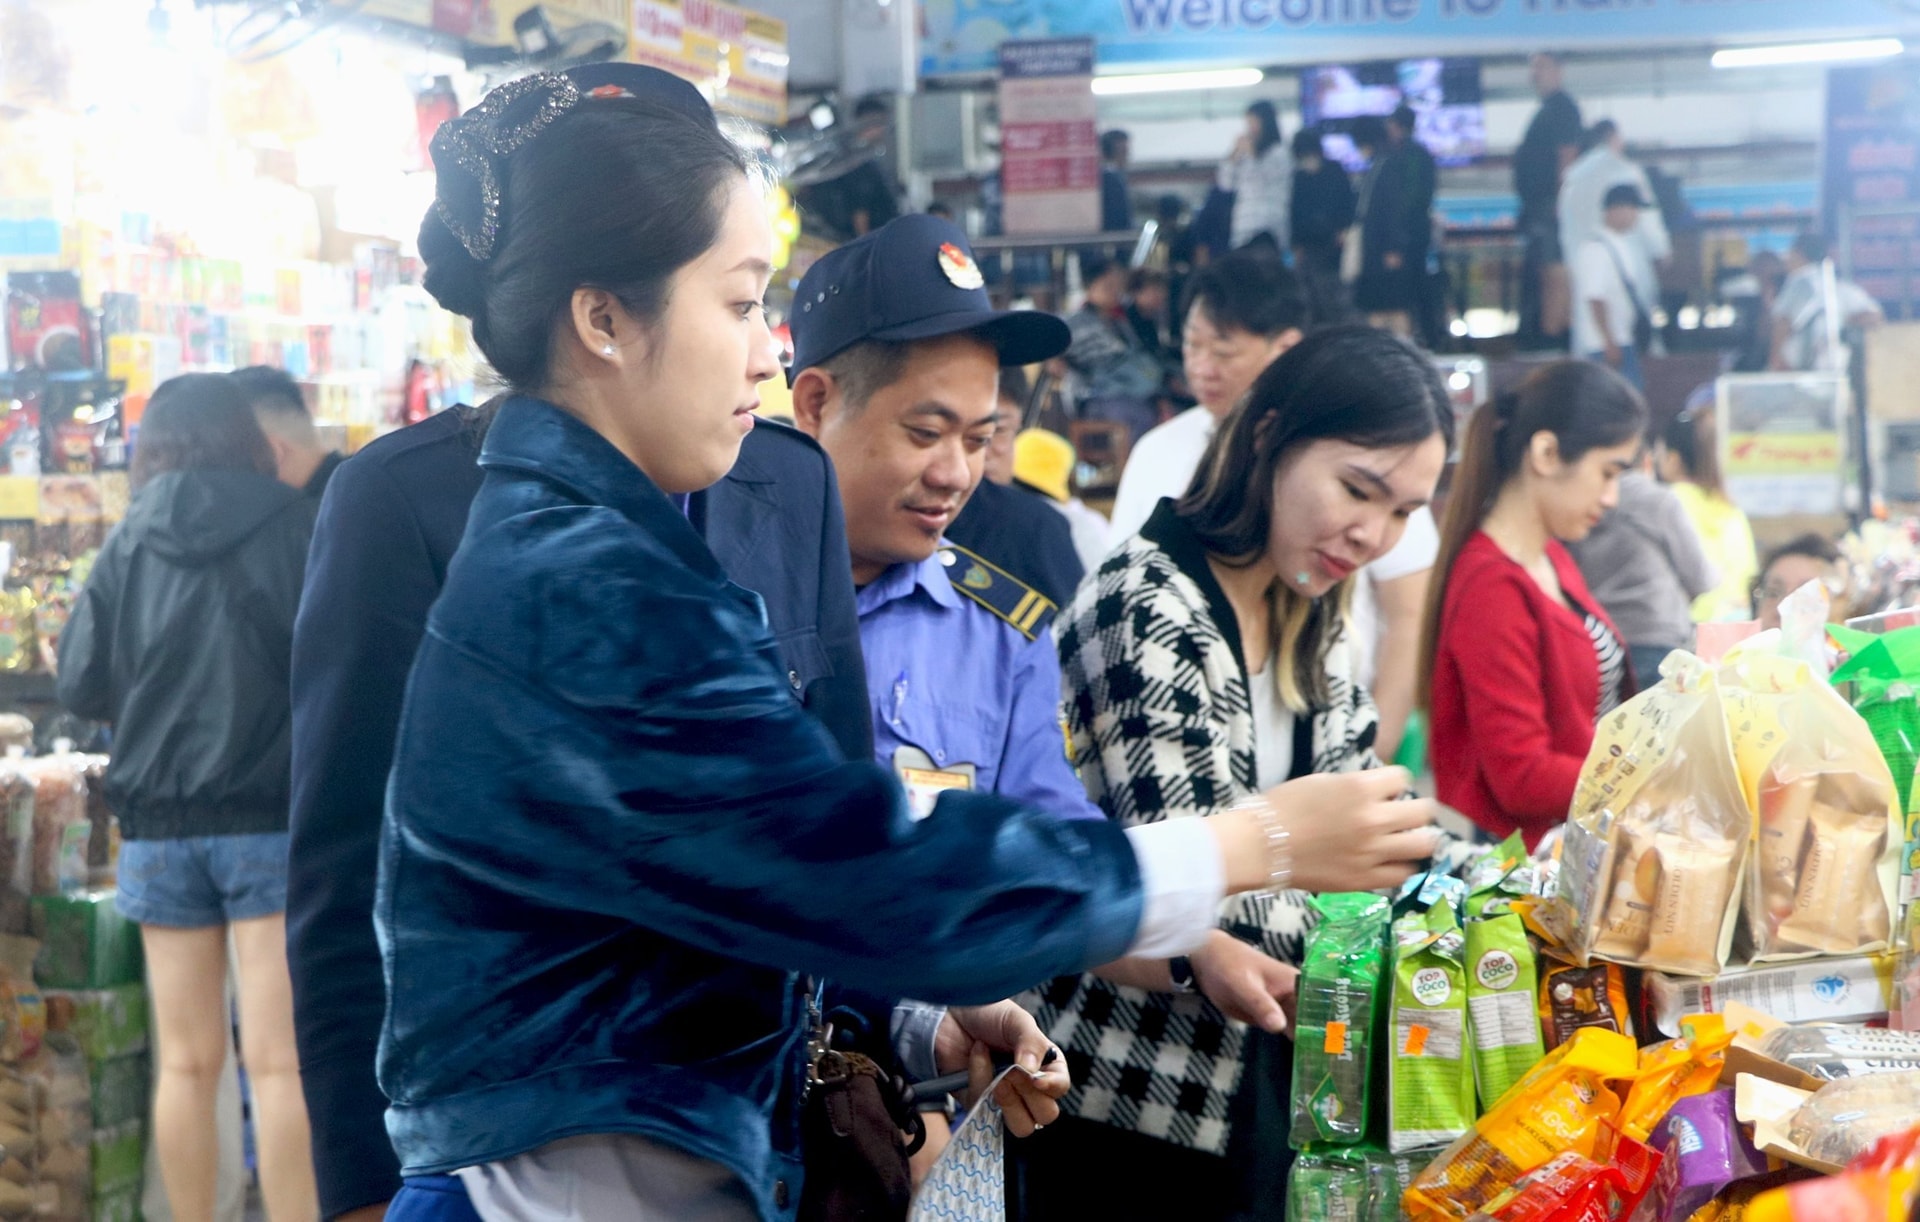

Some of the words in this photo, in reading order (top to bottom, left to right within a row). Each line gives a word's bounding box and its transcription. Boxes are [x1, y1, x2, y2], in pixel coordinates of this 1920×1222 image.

[1124, 0, 1420, 32] Welcome
[1668, 861, 1682, 909] OLDEN
[1484, 956, 1506, 970] TOP
[1418, 971, 1440, 984] TOP
[1481, 963, 1514, 979] COCO
[1416, 980, 1447, 994] COCO
